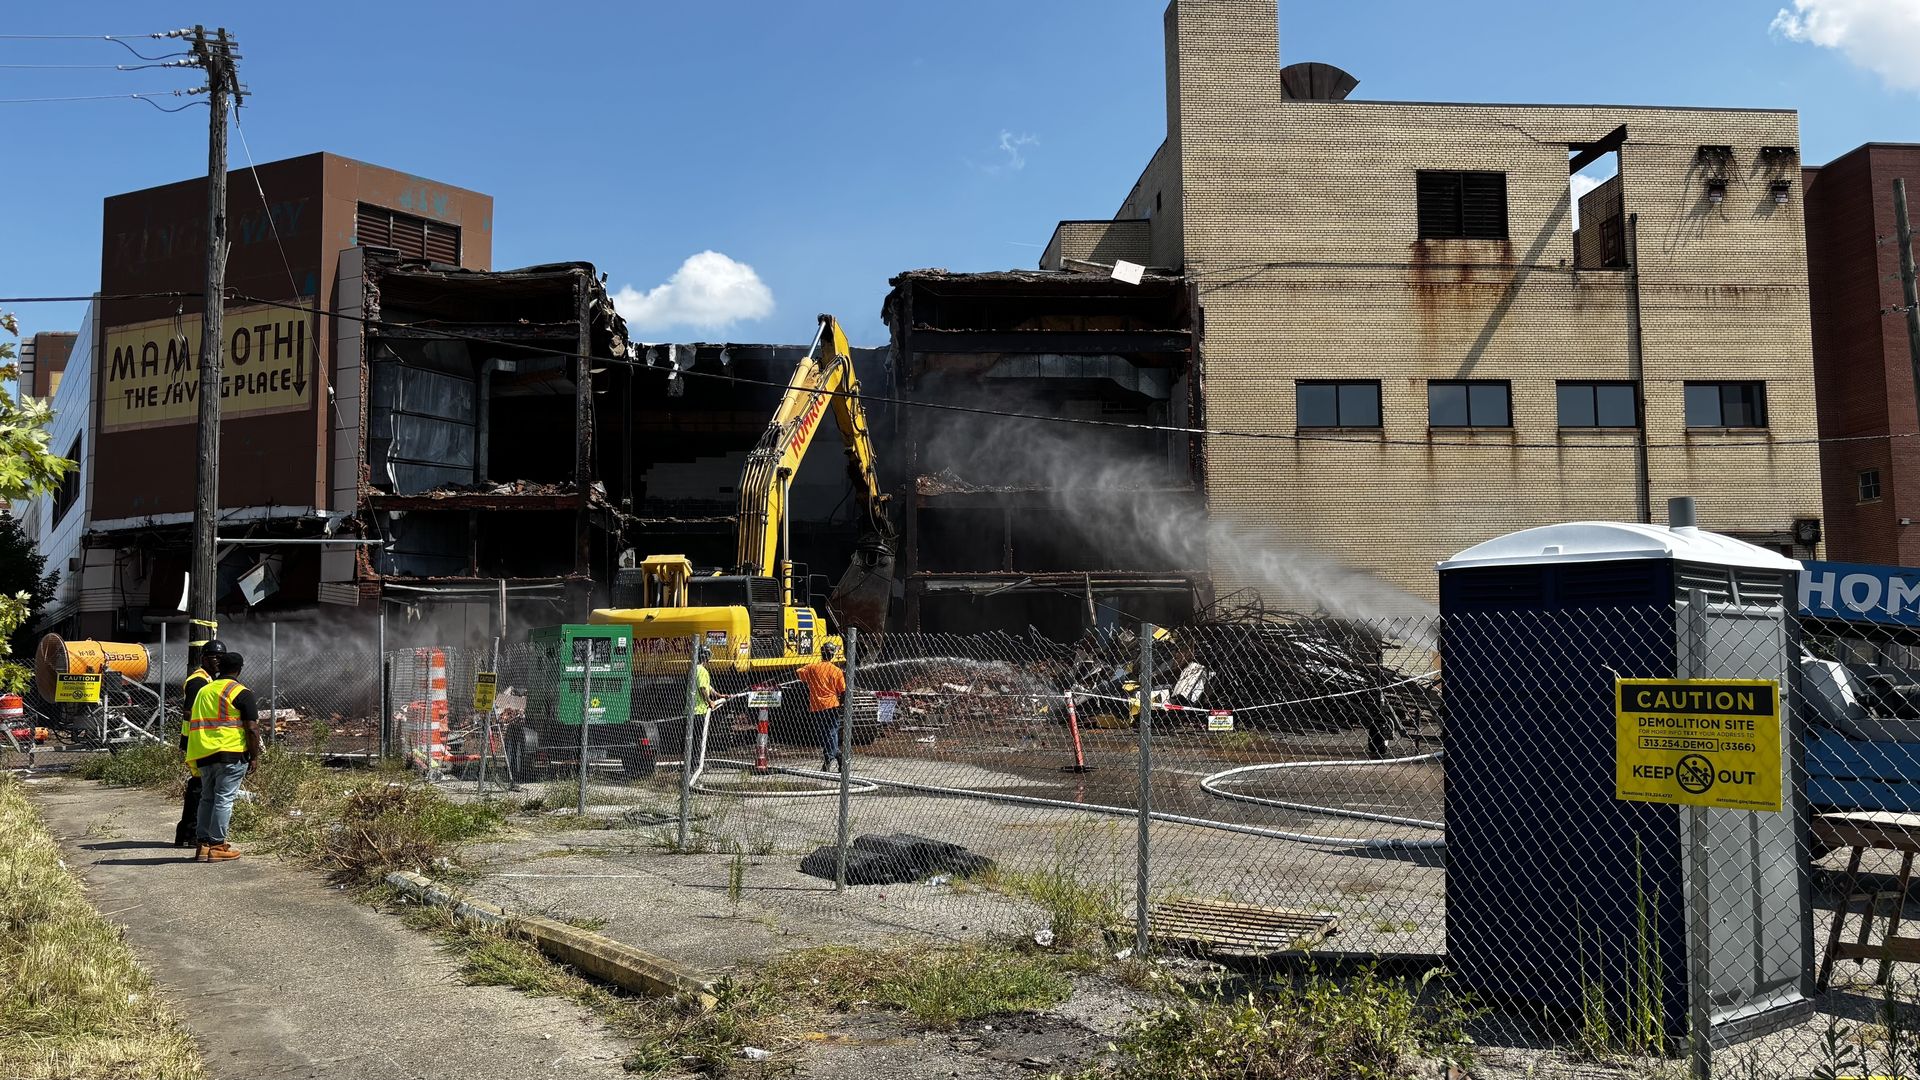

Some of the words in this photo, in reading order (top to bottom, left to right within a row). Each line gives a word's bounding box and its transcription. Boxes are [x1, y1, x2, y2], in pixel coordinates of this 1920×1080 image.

[110, 320, 293, 382] MAMOTH
[125, 385, 158, 410] THE
[162, 376, 230, 405] SAVG
[234, 368, 291, 397] PLACE
[1637, 690, 1754, 711] CAUTION
[1638, 717, 1720, 730] DEMOLITION
[1725, 719, 1755, 731] SITE
[1643, 738, 1714, 750] 313.254.DEMO
[1720, 742, 1756, 753] (3366)
[1632, 765, 1675, 780] KEEP
[1717, 770, 1756, 785] OUT
